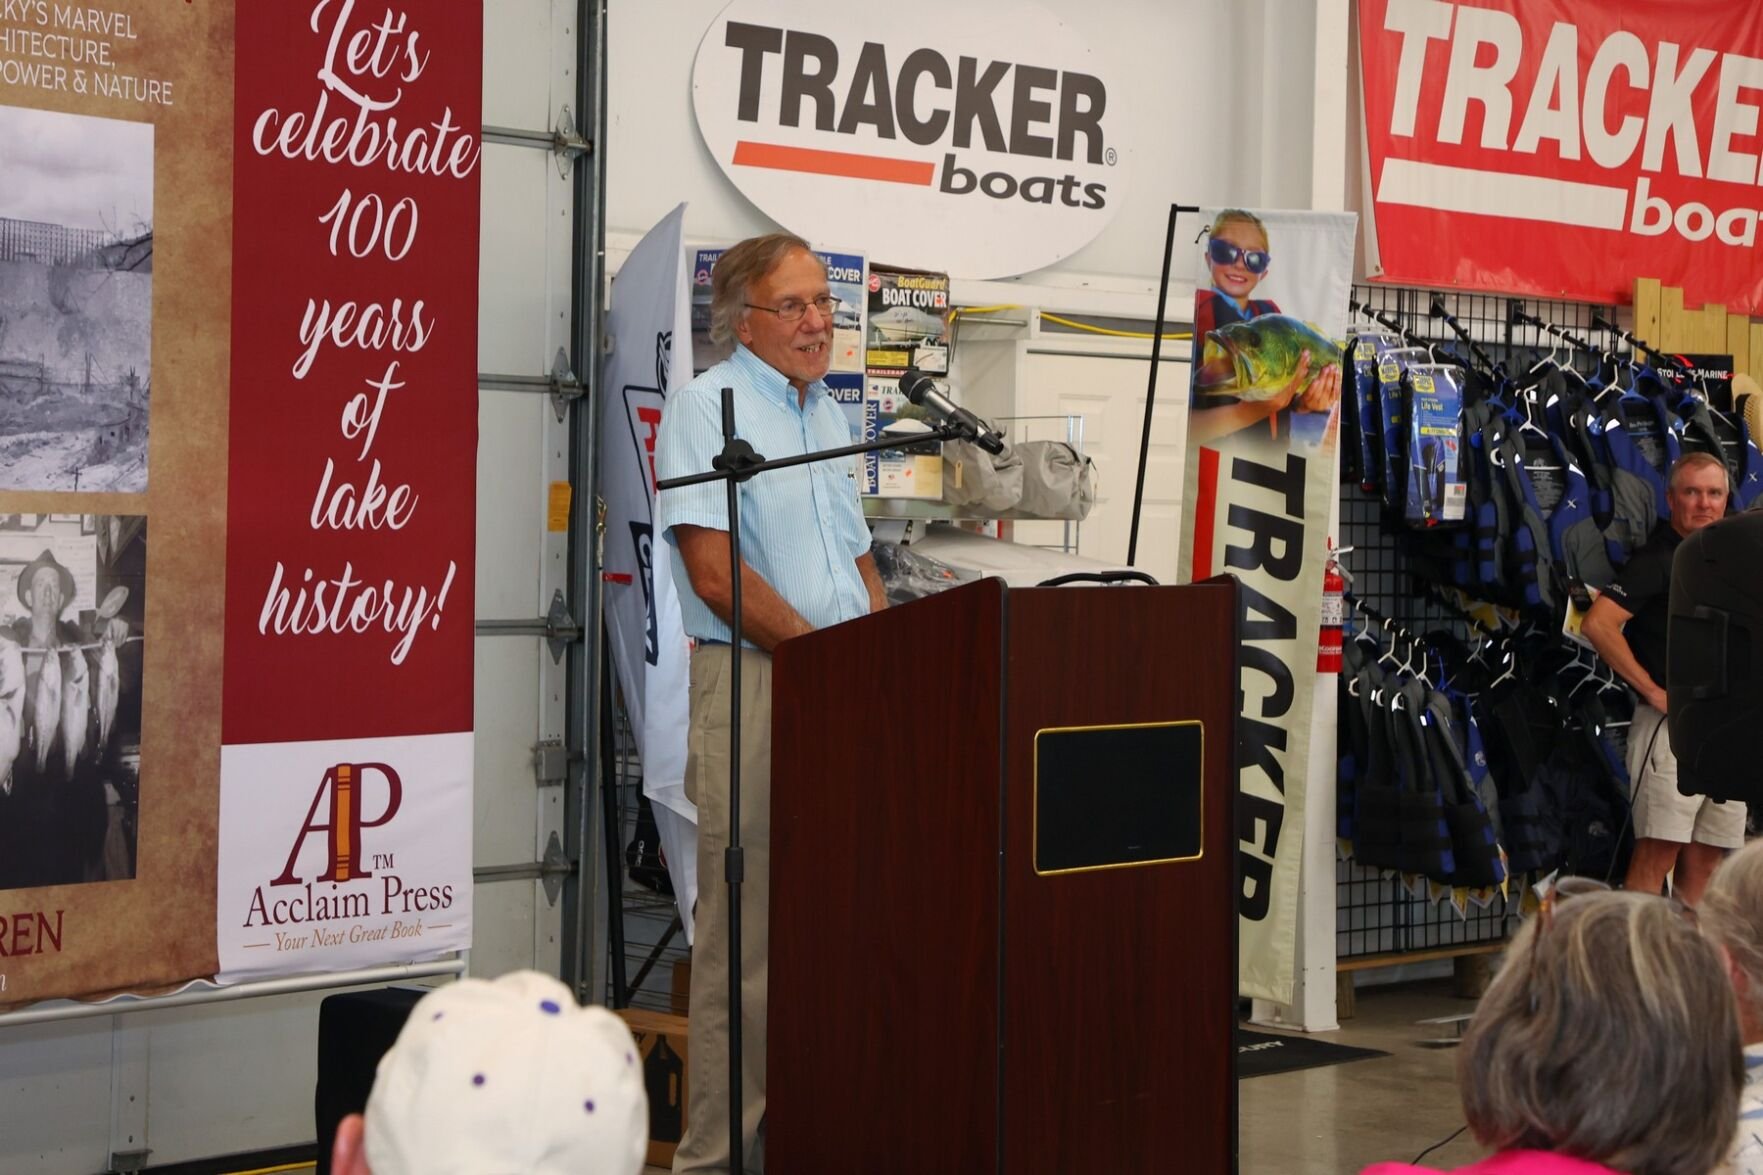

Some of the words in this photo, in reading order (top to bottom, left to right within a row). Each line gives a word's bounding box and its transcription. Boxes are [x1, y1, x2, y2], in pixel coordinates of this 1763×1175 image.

[0, 0, 48, 25] KY'S
[54, 4, 137, 39] MARVEL
[0, 59, 67, 91] OWER
[73, 70, 88, 94] &
[94, 72, 174, 105] NATURE
[311, 0, 430, 111] Let's
[725, 21, 1107, 165] TRACKER
[1383, 0, 1763, 187] TRACKE
[252, 90, 480, 178] celebrate
[939, 153, 1107, 210] boats
[1629, 177, 1763, 248] boa
[318, 189, 419, 261] 100
[882, 288, 911, 305] BOAT
[913, 291, 947, 308] COVER
[898, 275, 946, 290] BoatGuard
[293, 298, 435, 379] years
[342, 361, 406, 461] of
[829, 388, 860, 401] OVER
[865, 403, 877, 442] OVER
[311, 458, 419, 530] lake
[259, 560, 456, 665] history!
[270, 762, 402, 887] AP
[243, 882, 370, 927] Acclaim
[381, 876, 452, 915] Press
[275, 931, 308, 951] Your
[310, 928, 345, 947] Next
[350, 924, 386, 943] Great
[391, 919, 422, 938] Book
